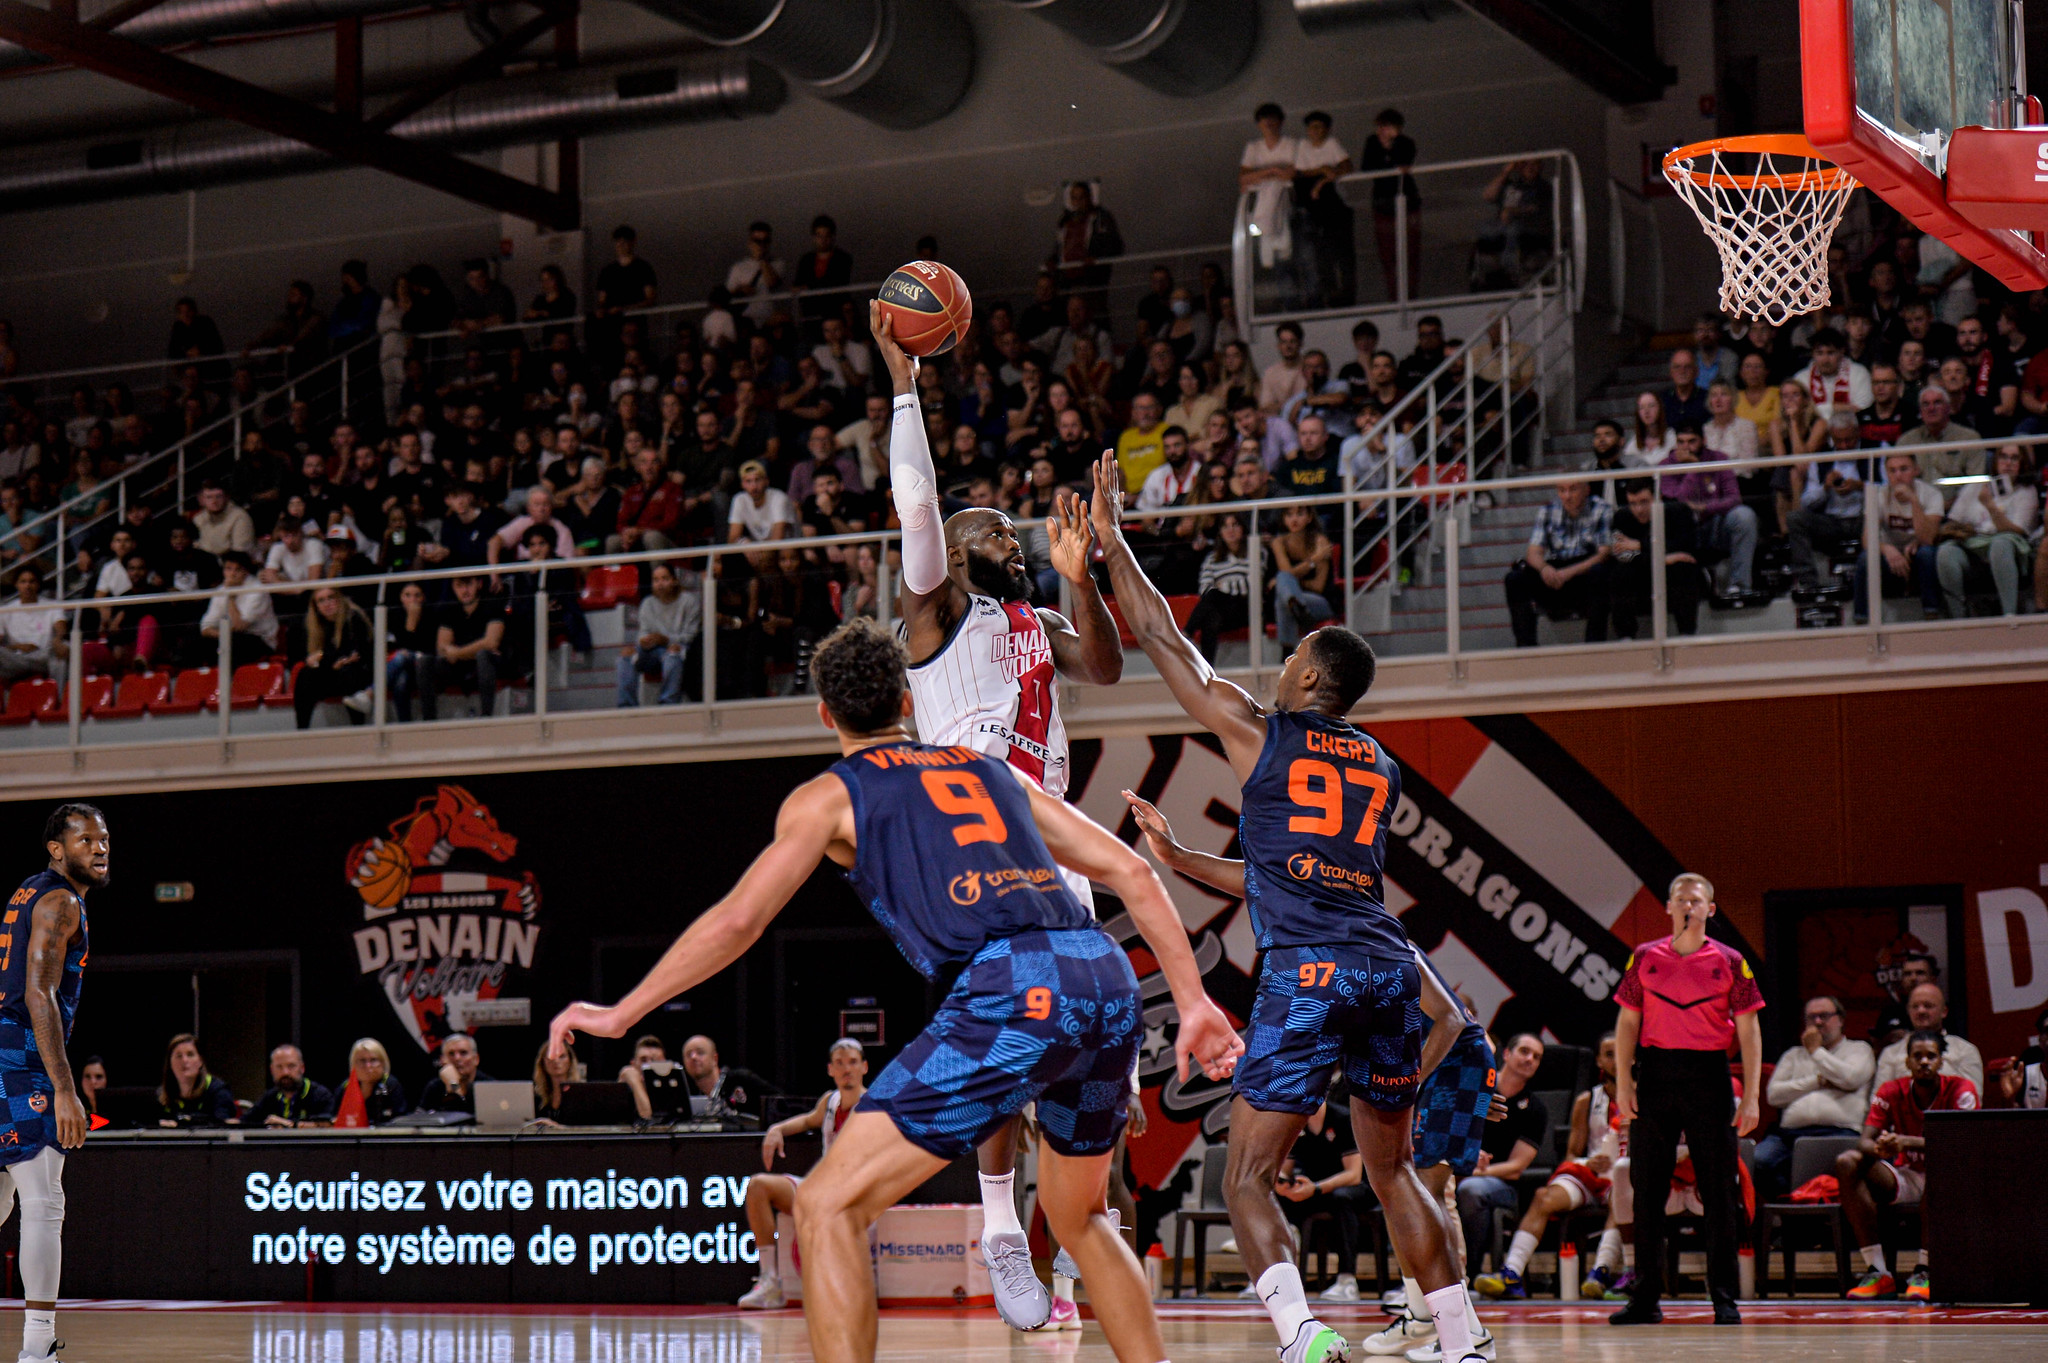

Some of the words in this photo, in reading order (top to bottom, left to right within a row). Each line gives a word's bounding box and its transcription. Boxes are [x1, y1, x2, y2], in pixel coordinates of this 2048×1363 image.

[1000, 648, 1054, 685] VOLTA
[1030, 678, 1042, 720] 1
[980, 723, 1050, 761] LESAFFRE
[1306, 729, 1376, 764] CHERY
[920, 769, 1008, 847] 9
[1288, 758, 1389, 847] 97
[985, 868, 1055, 887] trandev
[1388, 790, 1622, 1001] DRAGONS
[353, 914, 541, 975] DENAIN
[1299, 961, 1336, 988] 97
[1024, 986, 1052, 1021] 9
[245, 1171, 426, 1211] Sécurisez
[436, 1171, 533, 1210] votre
[546, 1168, 689, 1210] maison
[702, 1175, 750, 1208] av
[252, 1225, 346, 1265] notre
[357, 1225, 514, 1275] système
[528, 1224, 577, 1265] de
[589, 1222, 760, 1275] protectio
